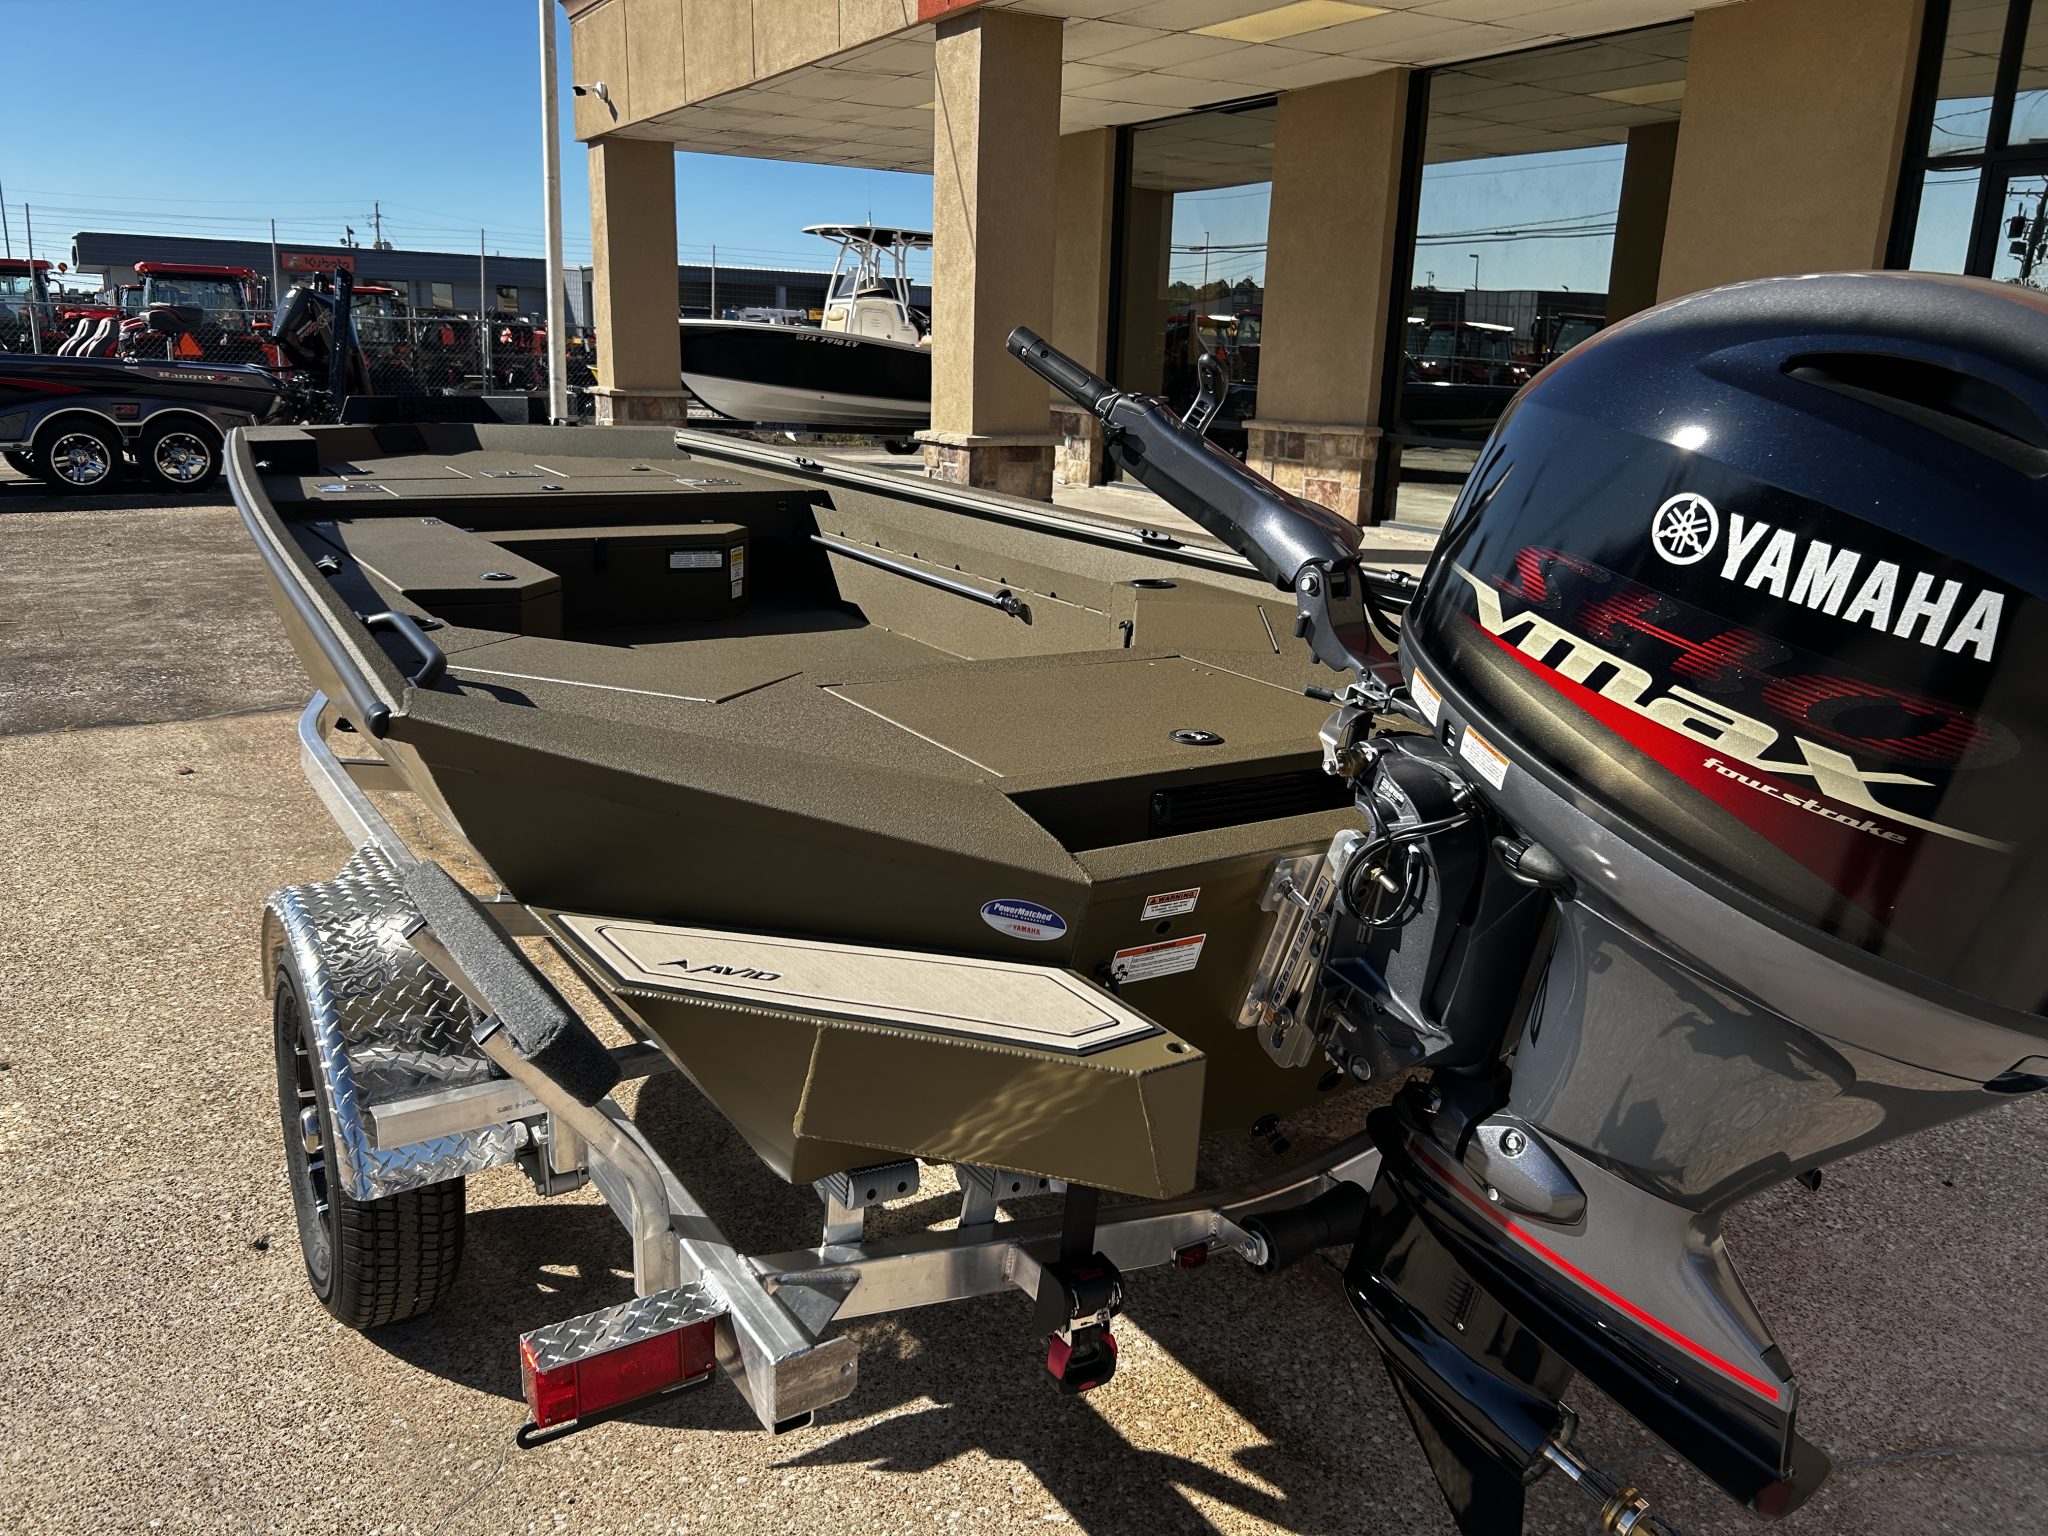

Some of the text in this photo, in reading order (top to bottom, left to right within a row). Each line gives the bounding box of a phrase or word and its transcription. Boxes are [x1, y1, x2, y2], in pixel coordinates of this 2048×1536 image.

[304, 256, 350, 268] Kubota
[158, 370, 214, 381] Ranger
[1719, 512, 2005, 662] YAMAHA
[1158, 890, 1195, 902] WARNING
[993, 902, 1053, 922] PowerMatched
[1012, 924, 1041, 936] YAMAHA
[685, 963, 782, 981] AVID
